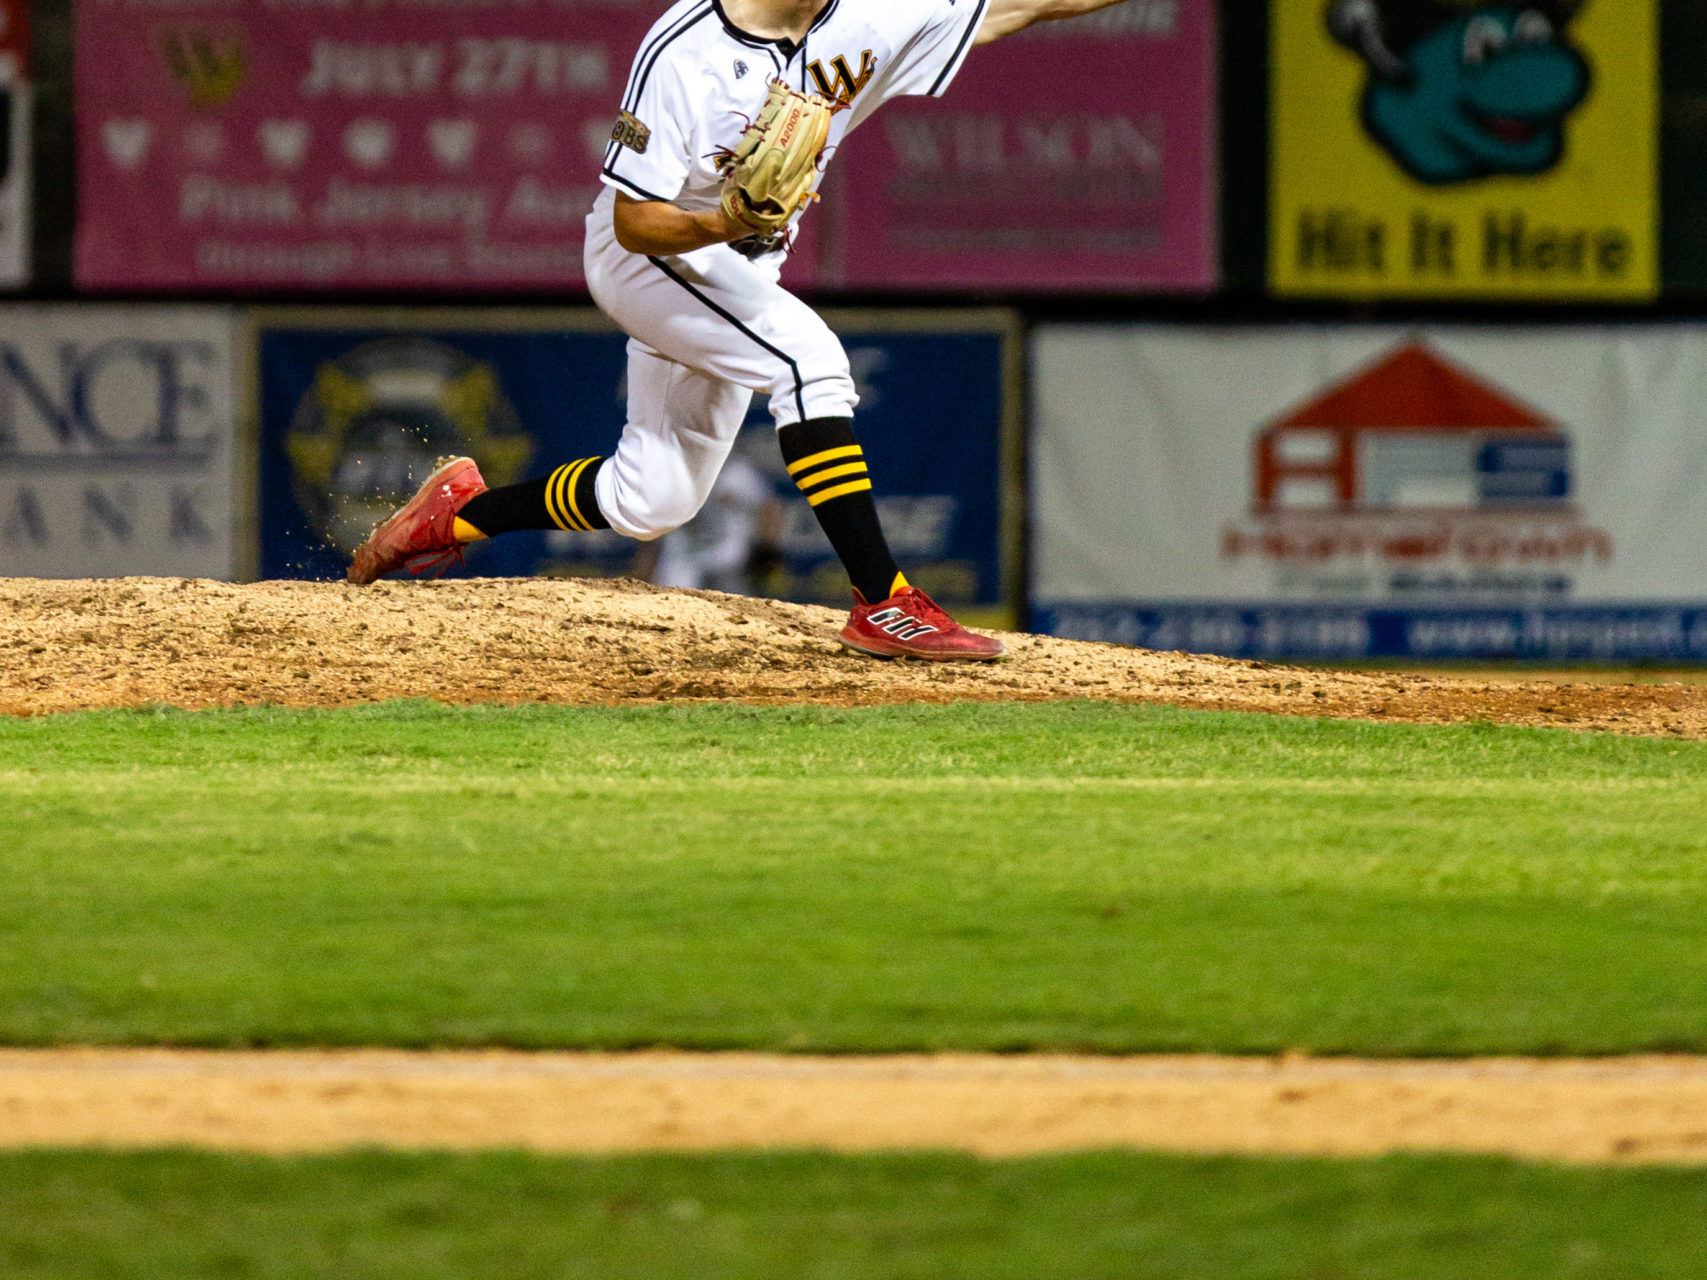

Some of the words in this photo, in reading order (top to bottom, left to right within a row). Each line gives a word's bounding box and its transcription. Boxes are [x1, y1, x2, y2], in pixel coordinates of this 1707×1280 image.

[780, 108, 800, 148] A2000
[885, 114, 1166, 172] WILSON
[1299, 210, 1388, 272] Hit
[1410, 210, 1456, 275] It
[1480, 208, 1634, 277] Here
